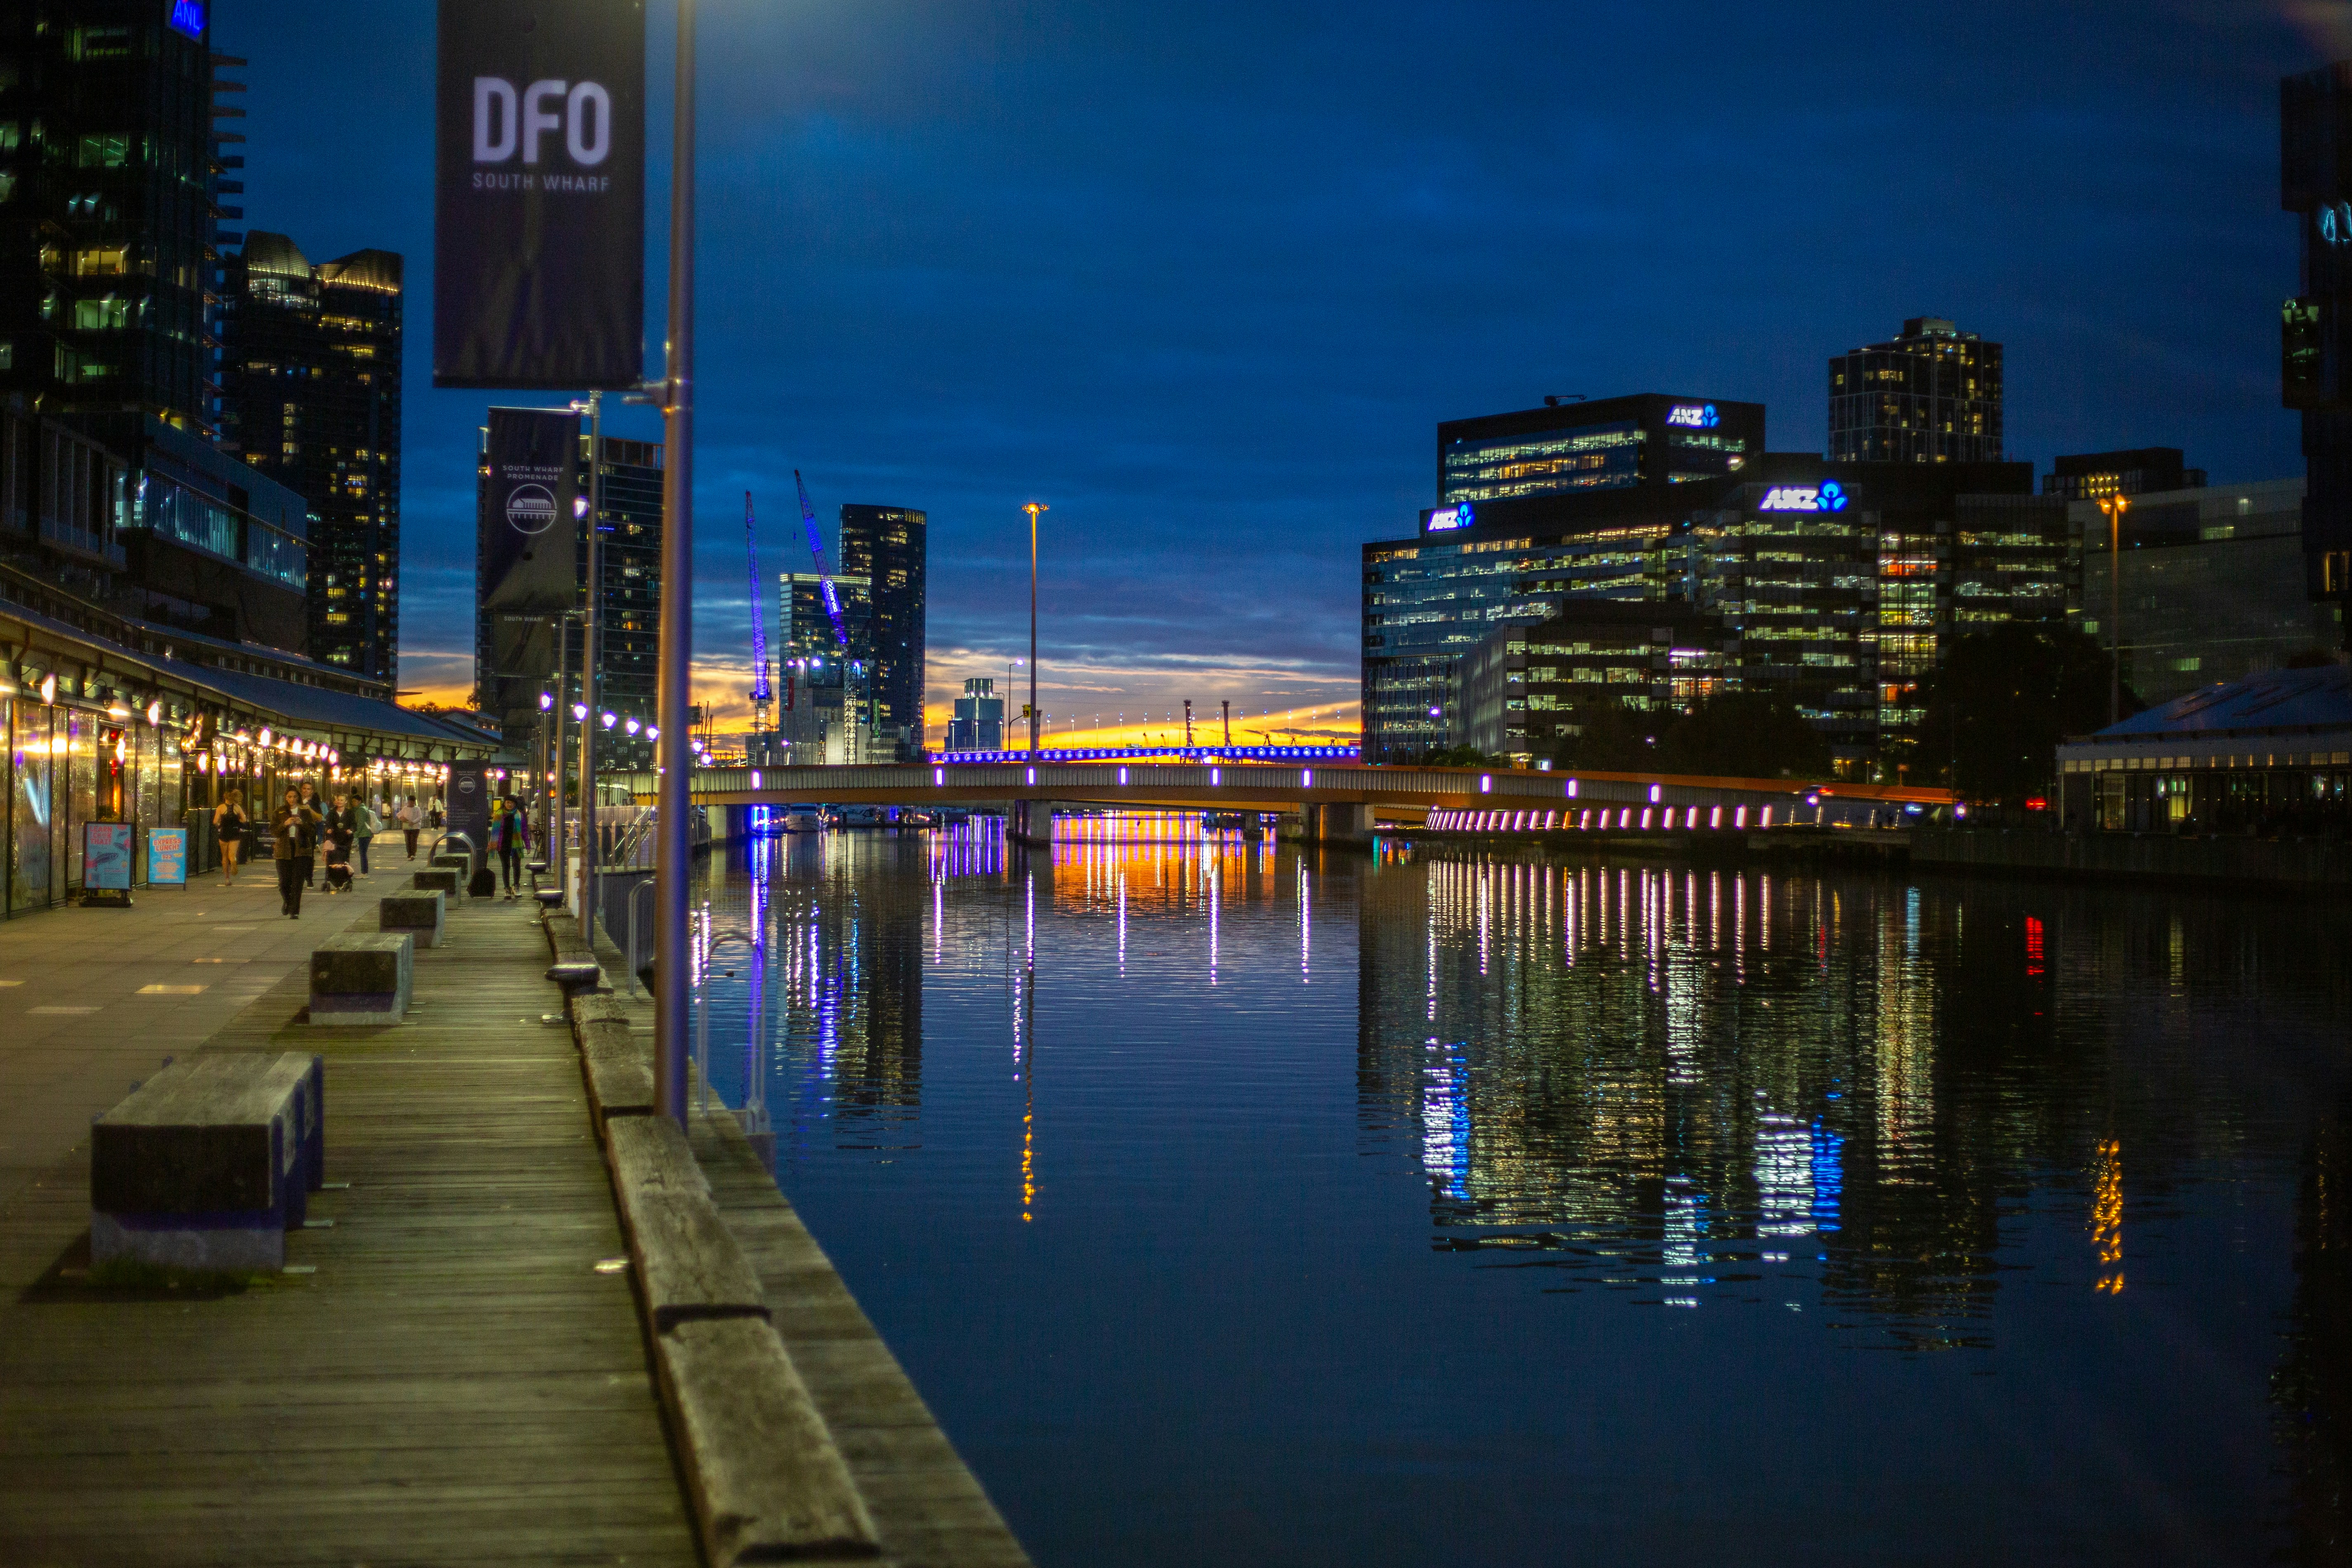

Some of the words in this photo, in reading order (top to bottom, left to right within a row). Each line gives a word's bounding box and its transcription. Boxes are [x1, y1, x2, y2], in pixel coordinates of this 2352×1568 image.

[174, 0, 200, 31] ANL
[473, 76, 610, 166] DFO
[473, 173, 534, 190] SOUTH
[543, 175, 610, 192] WHARF
[1669, 409, 1702, 426] ANZ
[1761, 489, 1818, 509] ANZ
[1429, 512, 1457, 530] ANZ
[829, 591, 838, 613] mirvac
[566, 735, 575, 743] FO
